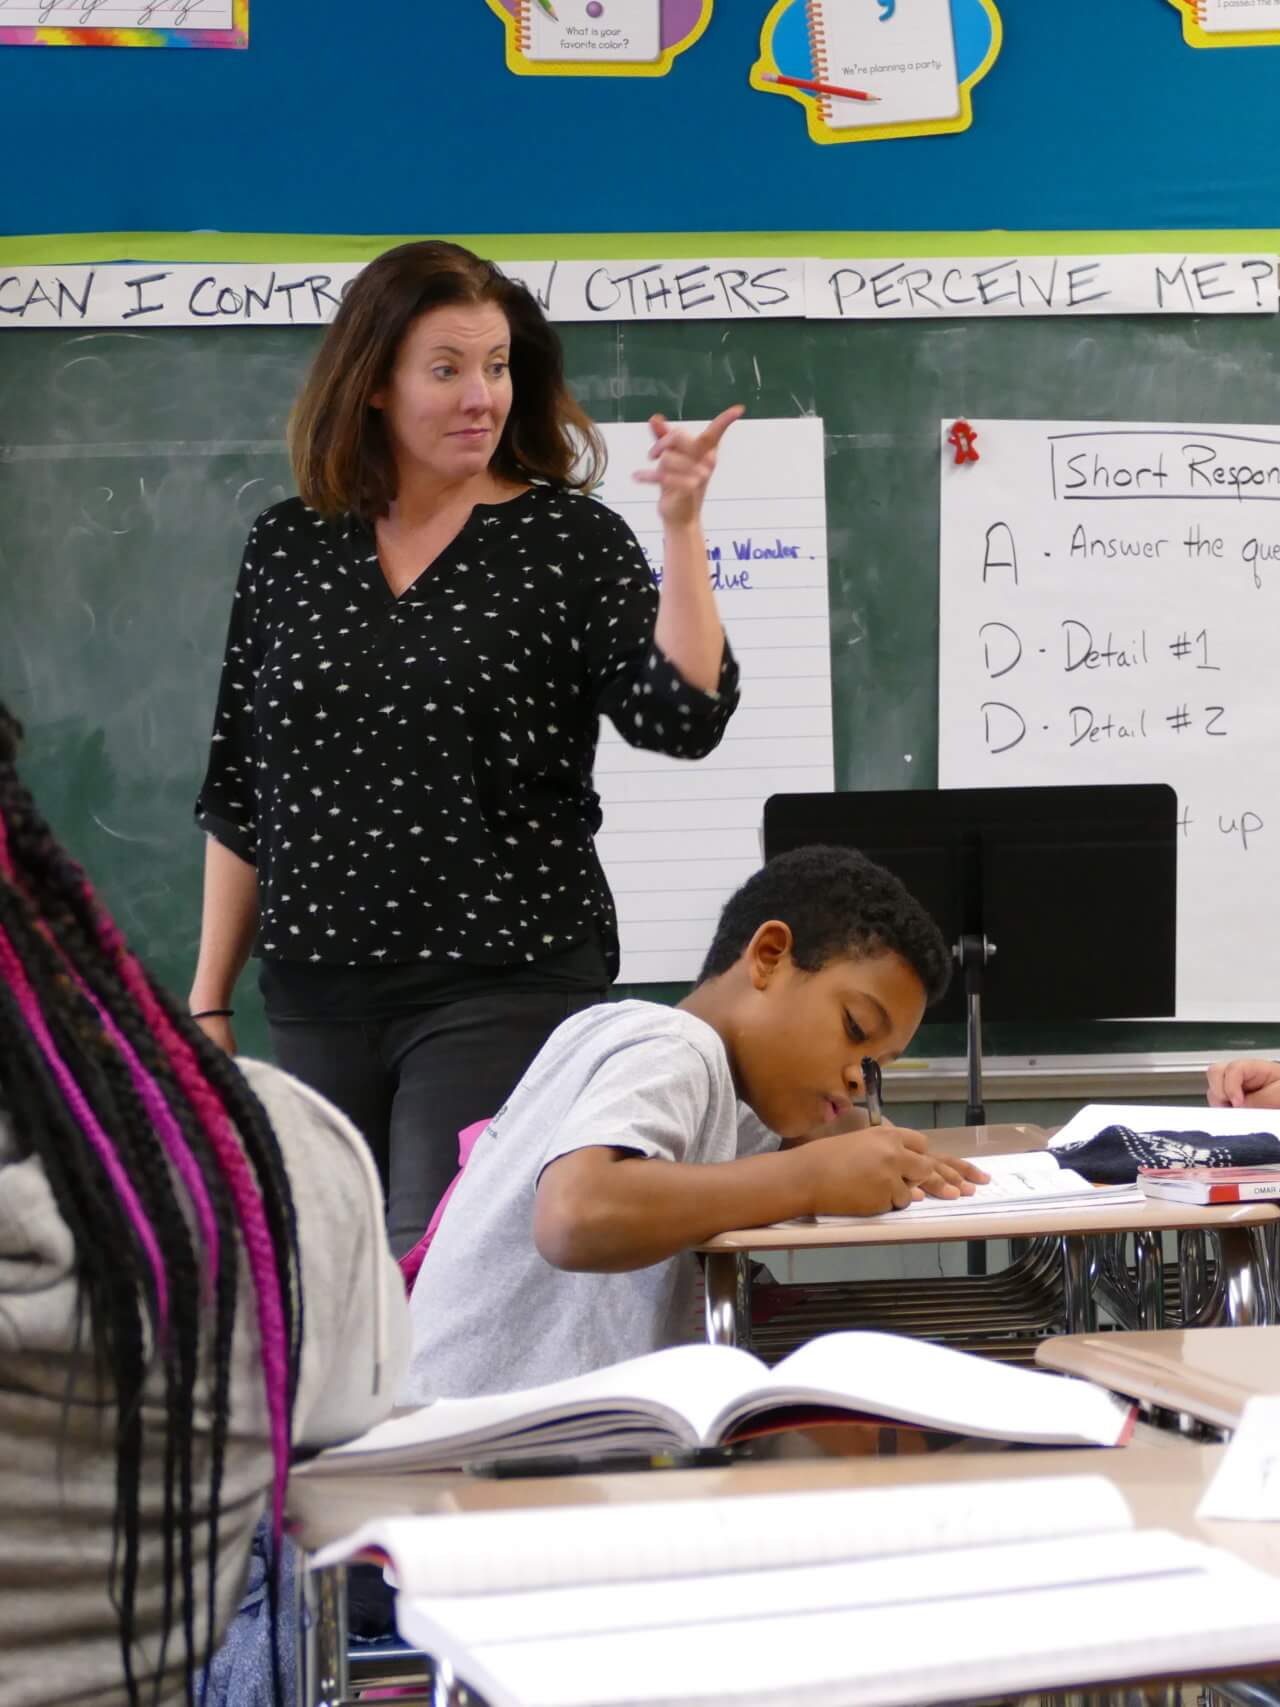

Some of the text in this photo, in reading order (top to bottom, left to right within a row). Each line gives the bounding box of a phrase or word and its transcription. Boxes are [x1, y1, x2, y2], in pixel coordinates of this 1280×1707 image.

[560, 38, 630, 49] favorite color?
[566, 27, 622, 38] What is your
[842, 64, 868, 76] We're
[869, 63, 906, 76] planning
[0, 271, 352, 320] CAN I CONTR
[585, 263, 790, 316] OTHERS
[829, 258, 1112, 315] PERCEIVE
[1155, 256, 1274, 312] ME?
[1064, 449, 1169, 488] Short
[1070, 524, 1168, 559] Answer
[1183, 523, 1224, 559] the
[1061, 619, 1149, 672] Detail
[1169, 628, 1221, 671] #1
[1069, 706, 1146, 746] Detail
[1217, 811, 1265, 850] up
[1254, 1186, 1277, 1195] OMAR
